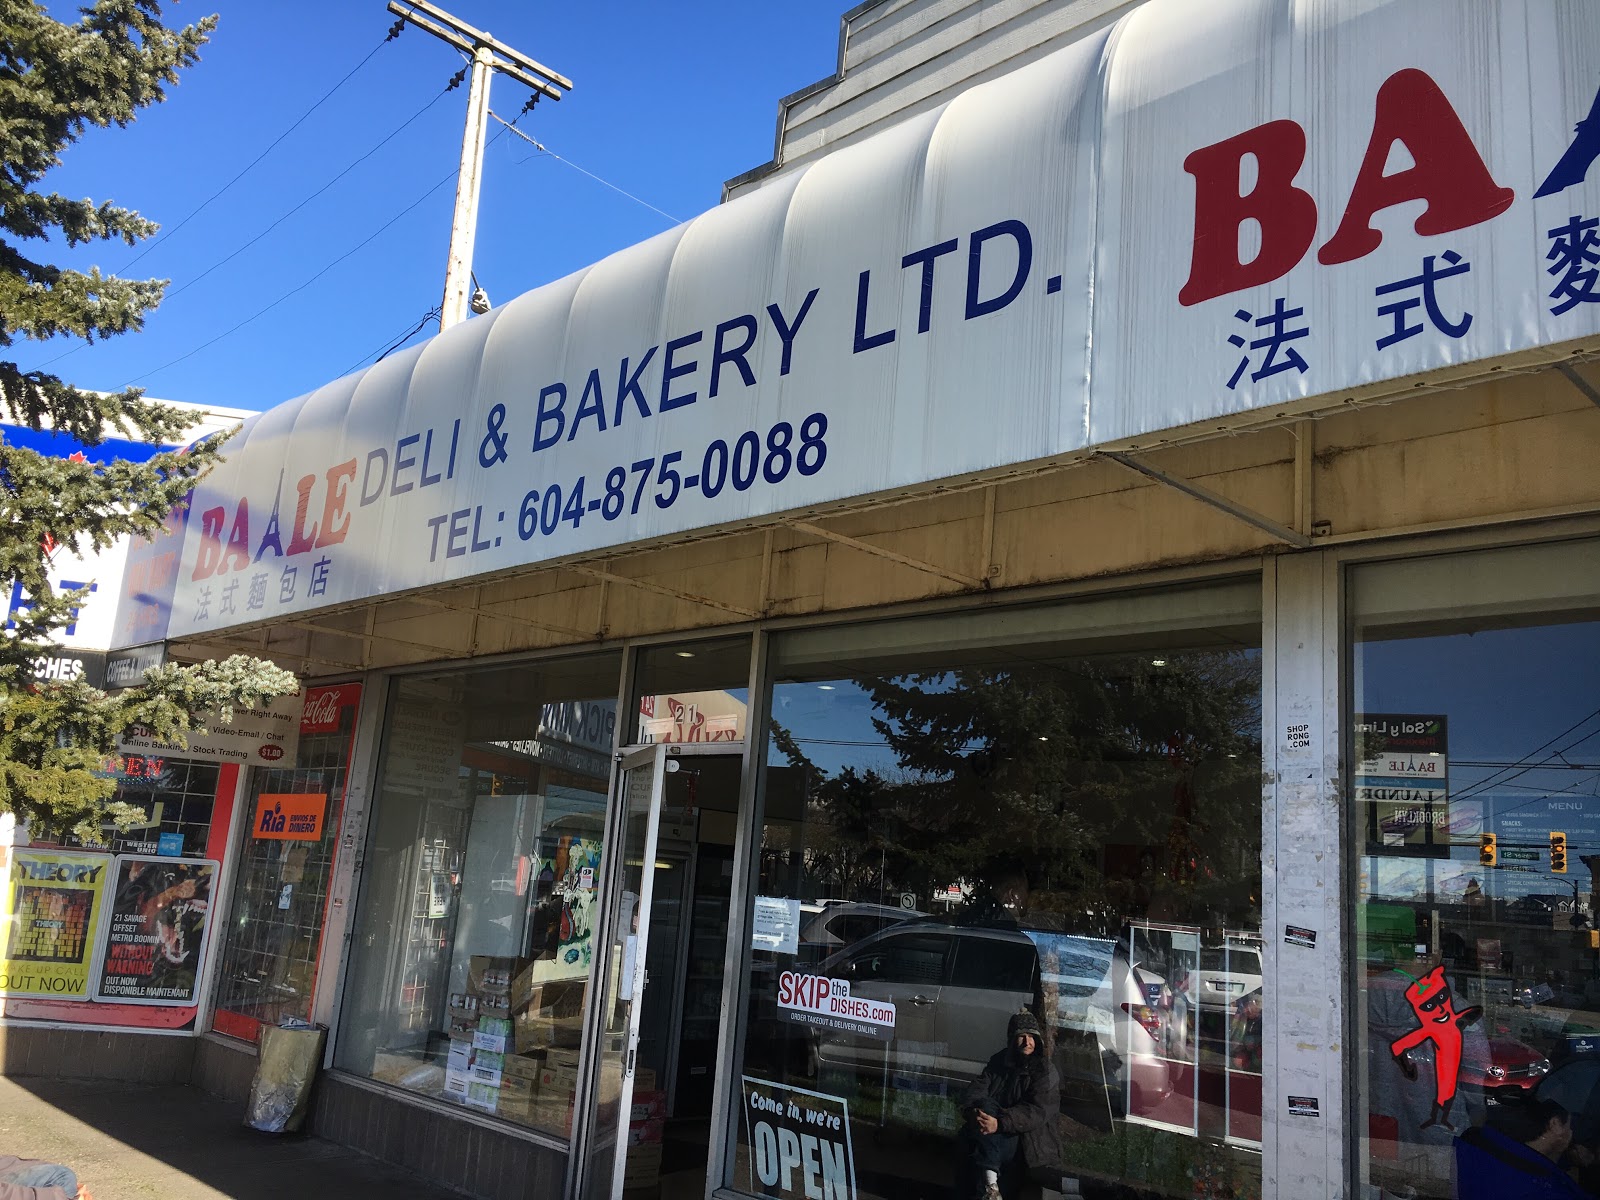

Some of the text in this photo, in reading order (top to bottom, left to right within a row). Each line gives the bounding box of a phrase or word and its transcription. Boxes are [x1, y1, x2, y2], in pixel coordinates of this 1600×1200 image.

[359, 219, 1062, 507] DELI & BAKERY LTD.
[428, 412, 828, 563] TEL: 604-875-0088
[29, 656, 83, 681] CHES
[250, 708, 272, 721] Right
[272, 712, 293, 723] Away
[212, 726, 260, 739] Video-Email
[266, 732, 284, 741] Chat
[1287, 724, 1309, 733] SHOP
[1287, 732, 1310, 741] RONG
[1290, 740, 1310, 748] .COM
[193, 745, 216, 756] Stock
[218, 747, 249, 760] Trading
[261, 747, 282, 759] $1.00
[104, 757, 164, 776] PEN
[1548, 802, 1583, 810] MENU
[259, 801, 286, 832] Ria
[309, 814, 317, 822] DE
[288, 823, 316, 833] DINERO
[18, 861, 104, 884] THEORY
[36, 919, 64, 928] THEORY
[114, 913, 148, 923] 21 SAVAGE
[113, 923, 137, 933] OFFSET
[111, 933, 160, 944] METRO BOOMIN
[111, 943, 154, 959] WITHOUT
[36, 966, 54, 975] UP
[56, 965, 85, 977] CALL
[107, 959, 154, 975] WARNING
[39, 977, 85, 992] NOW
[105, 976, 138, 986] OUT NOW
[104, 985, 190, 998] DISPONIBLE MAINTENANT
[779, 973, 830, 1009] SKIP
[831, 981, 848, 997] the
[830, 997, 893, 1023] DISHES.com
[790, 1012, 877, 1035] ORDER TAKEOUT & DELIVERY ONLINE
[750, 1090, 841, 1131] Come in, we're
[754, 1120, 848, 1200] OPEN
